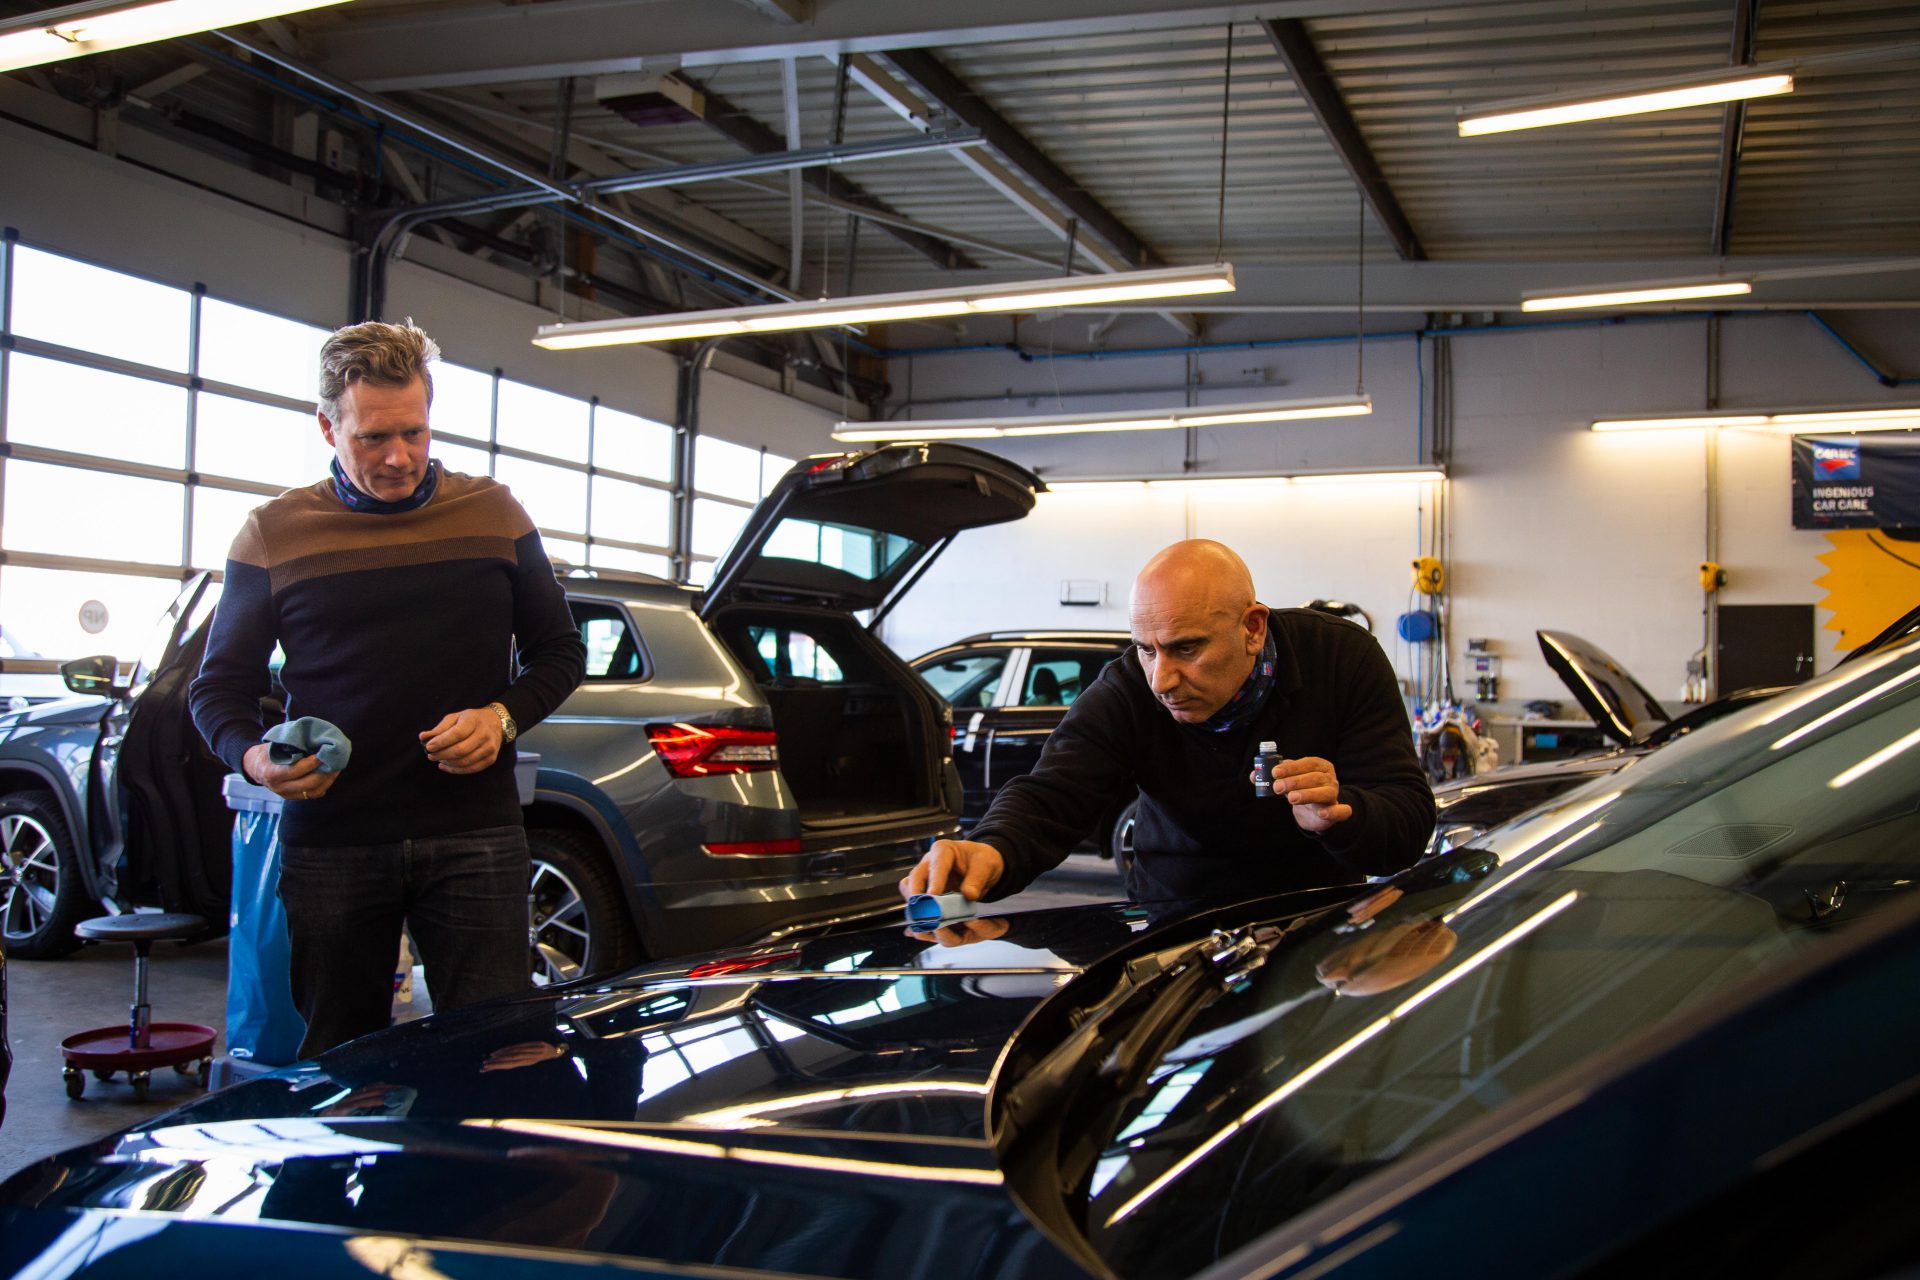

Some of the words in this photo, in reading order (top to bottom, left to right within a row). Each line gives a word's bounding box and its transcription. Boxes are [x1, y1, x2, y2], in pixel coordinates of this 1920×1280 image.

[1812, 486, 1874, 499] INGENIOUS
[1813, 500, 1836, 511] CAR
[1837, 499, 1868, 511] CARE
